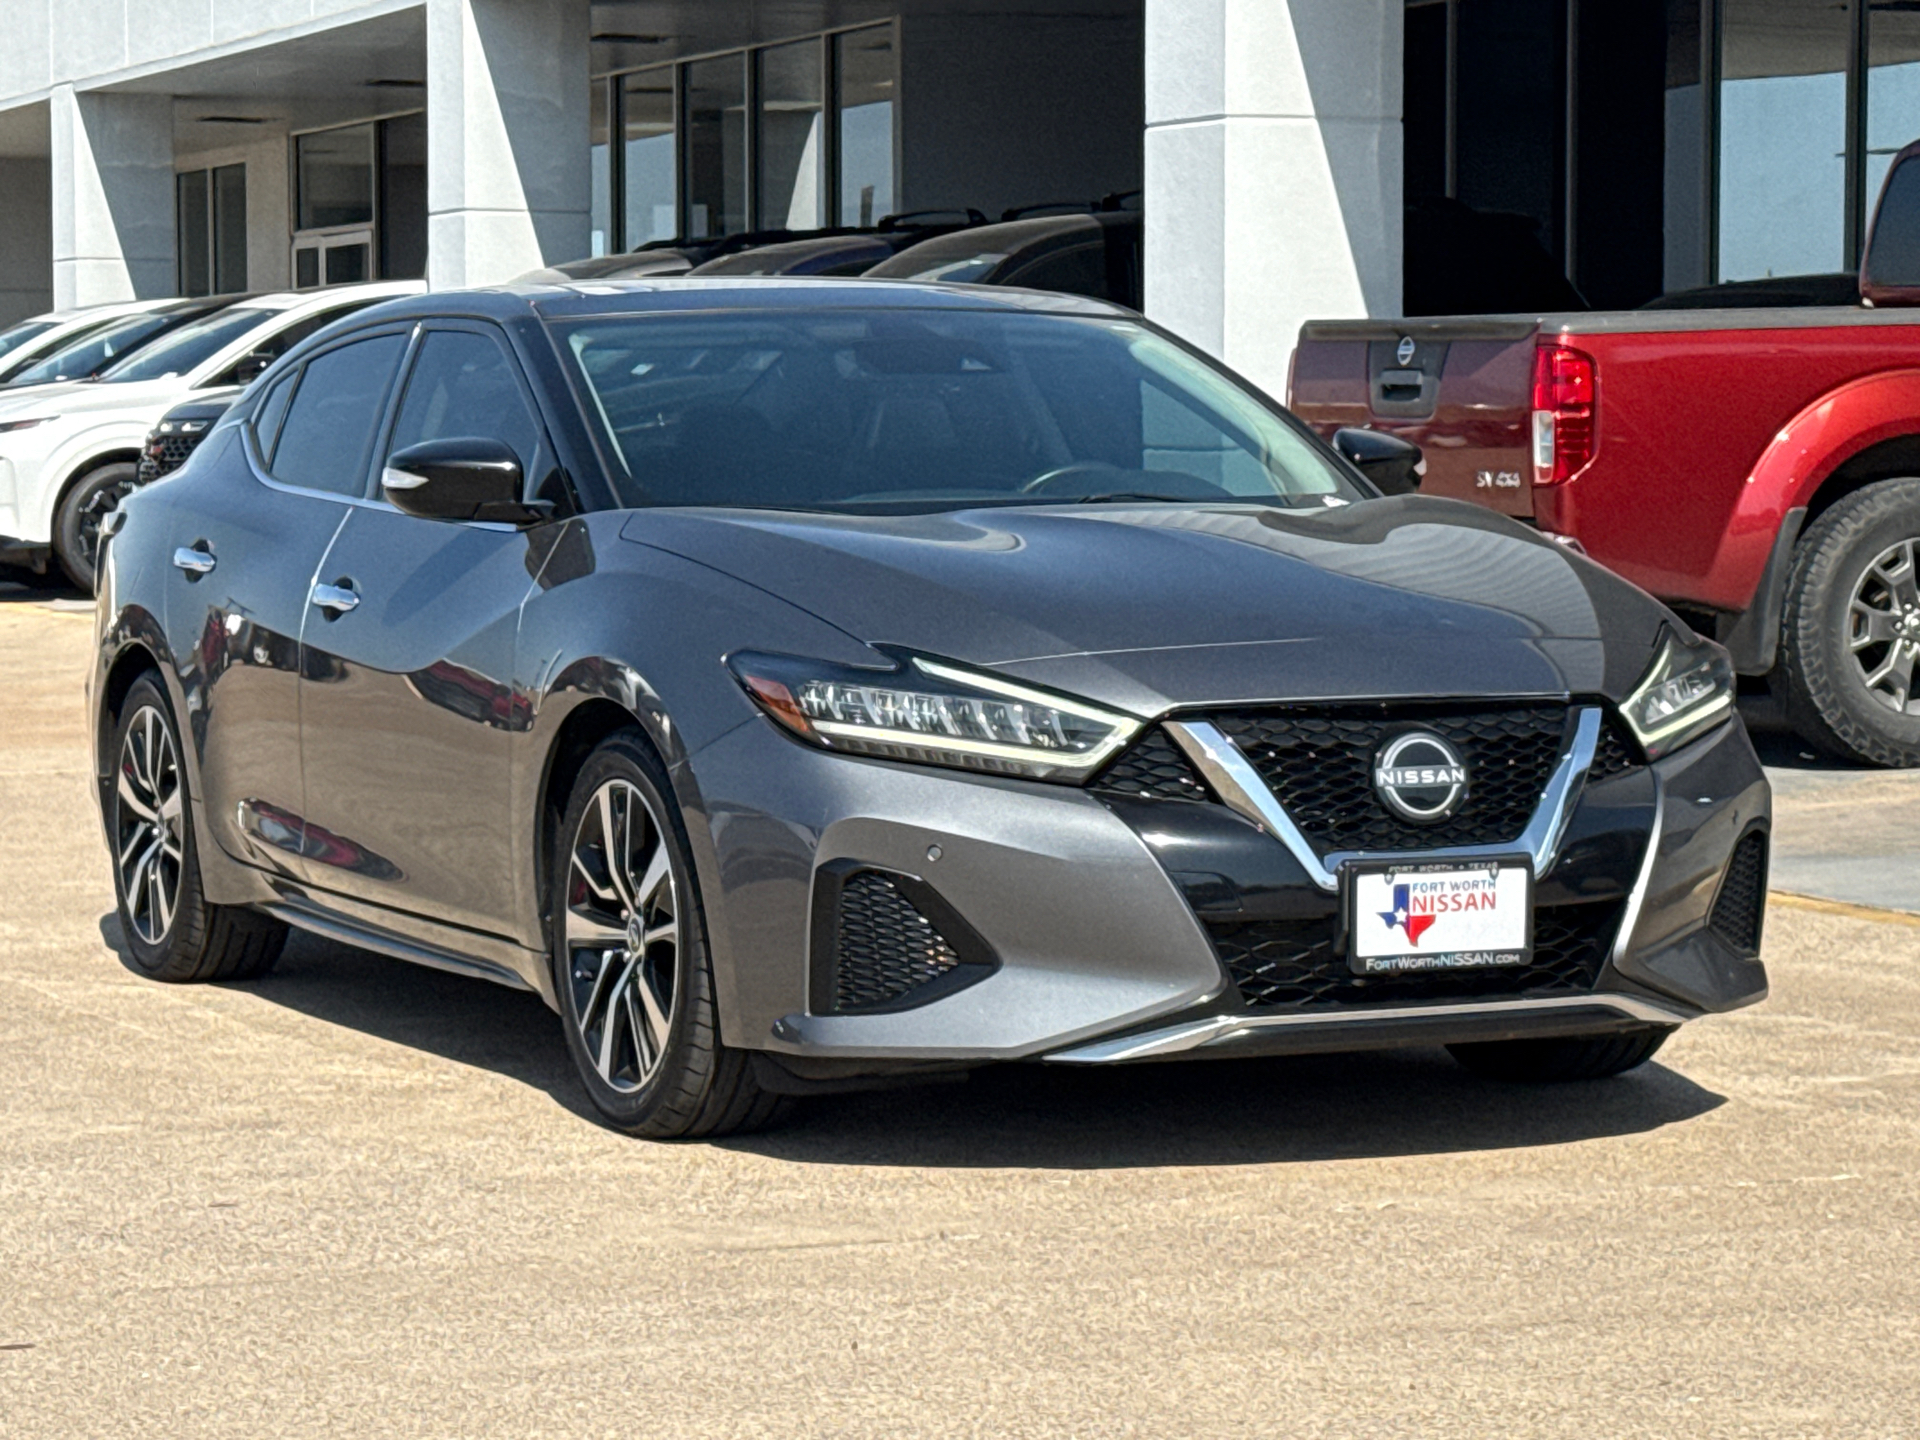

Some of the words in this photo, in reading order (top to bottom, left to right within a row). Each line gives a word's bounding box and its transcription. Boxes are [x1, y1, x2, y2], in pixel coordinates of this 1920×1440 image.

[1476, 470, 1494, 488] SV
[1379, 768, 1465, 785] NISSAN
[1419, 863, 1453, 873] WORTH
[1412, 881, 1445, 893] FORT
[1449, 879, 1496, 892] WORTH
[1412, 891, 1496, 913] NISSAN
